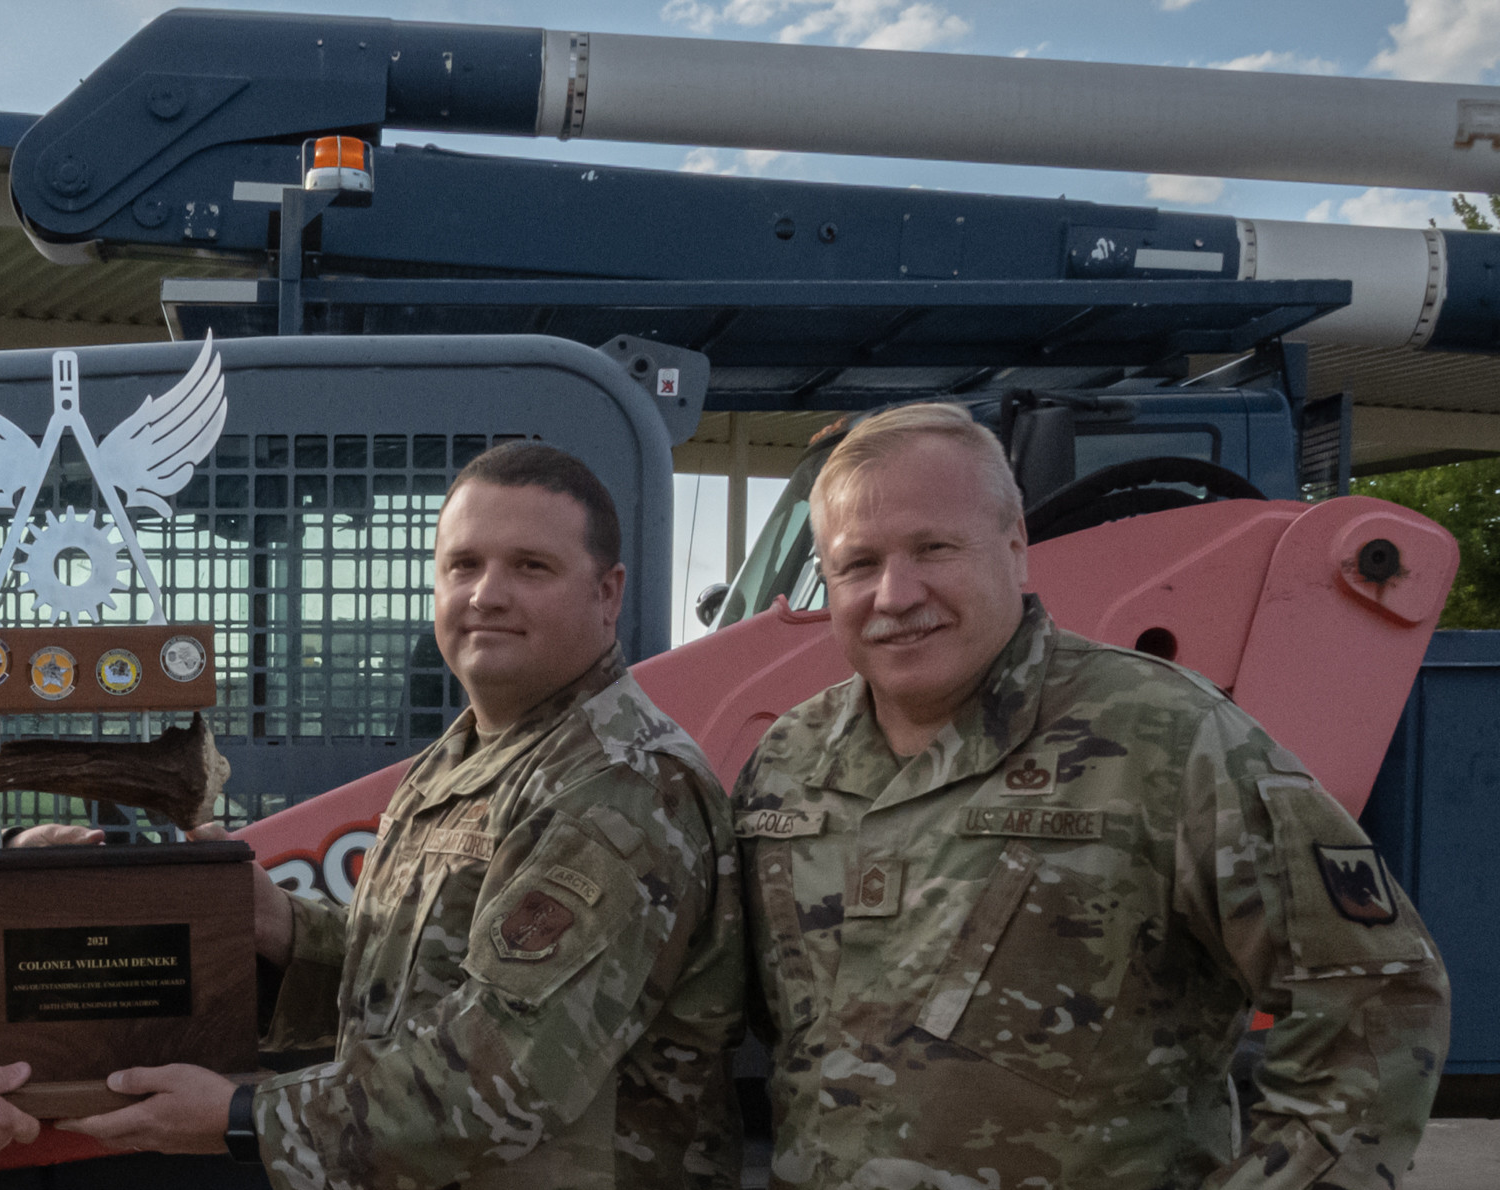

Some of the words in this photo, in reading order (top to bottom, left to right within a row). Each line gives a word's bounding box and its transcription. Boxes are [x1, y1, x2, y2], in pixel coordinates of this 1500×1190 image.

[1002, 811, 1032, 832] AIR
[1039, 813, 1095, 835] FORCE
[86, 936, 109, 947] 2021
[18, 960, 74, 972] COLONEL
[75, 958, 129, 970] WILLIAM
[131, 956, 178, 968] DENEKE
